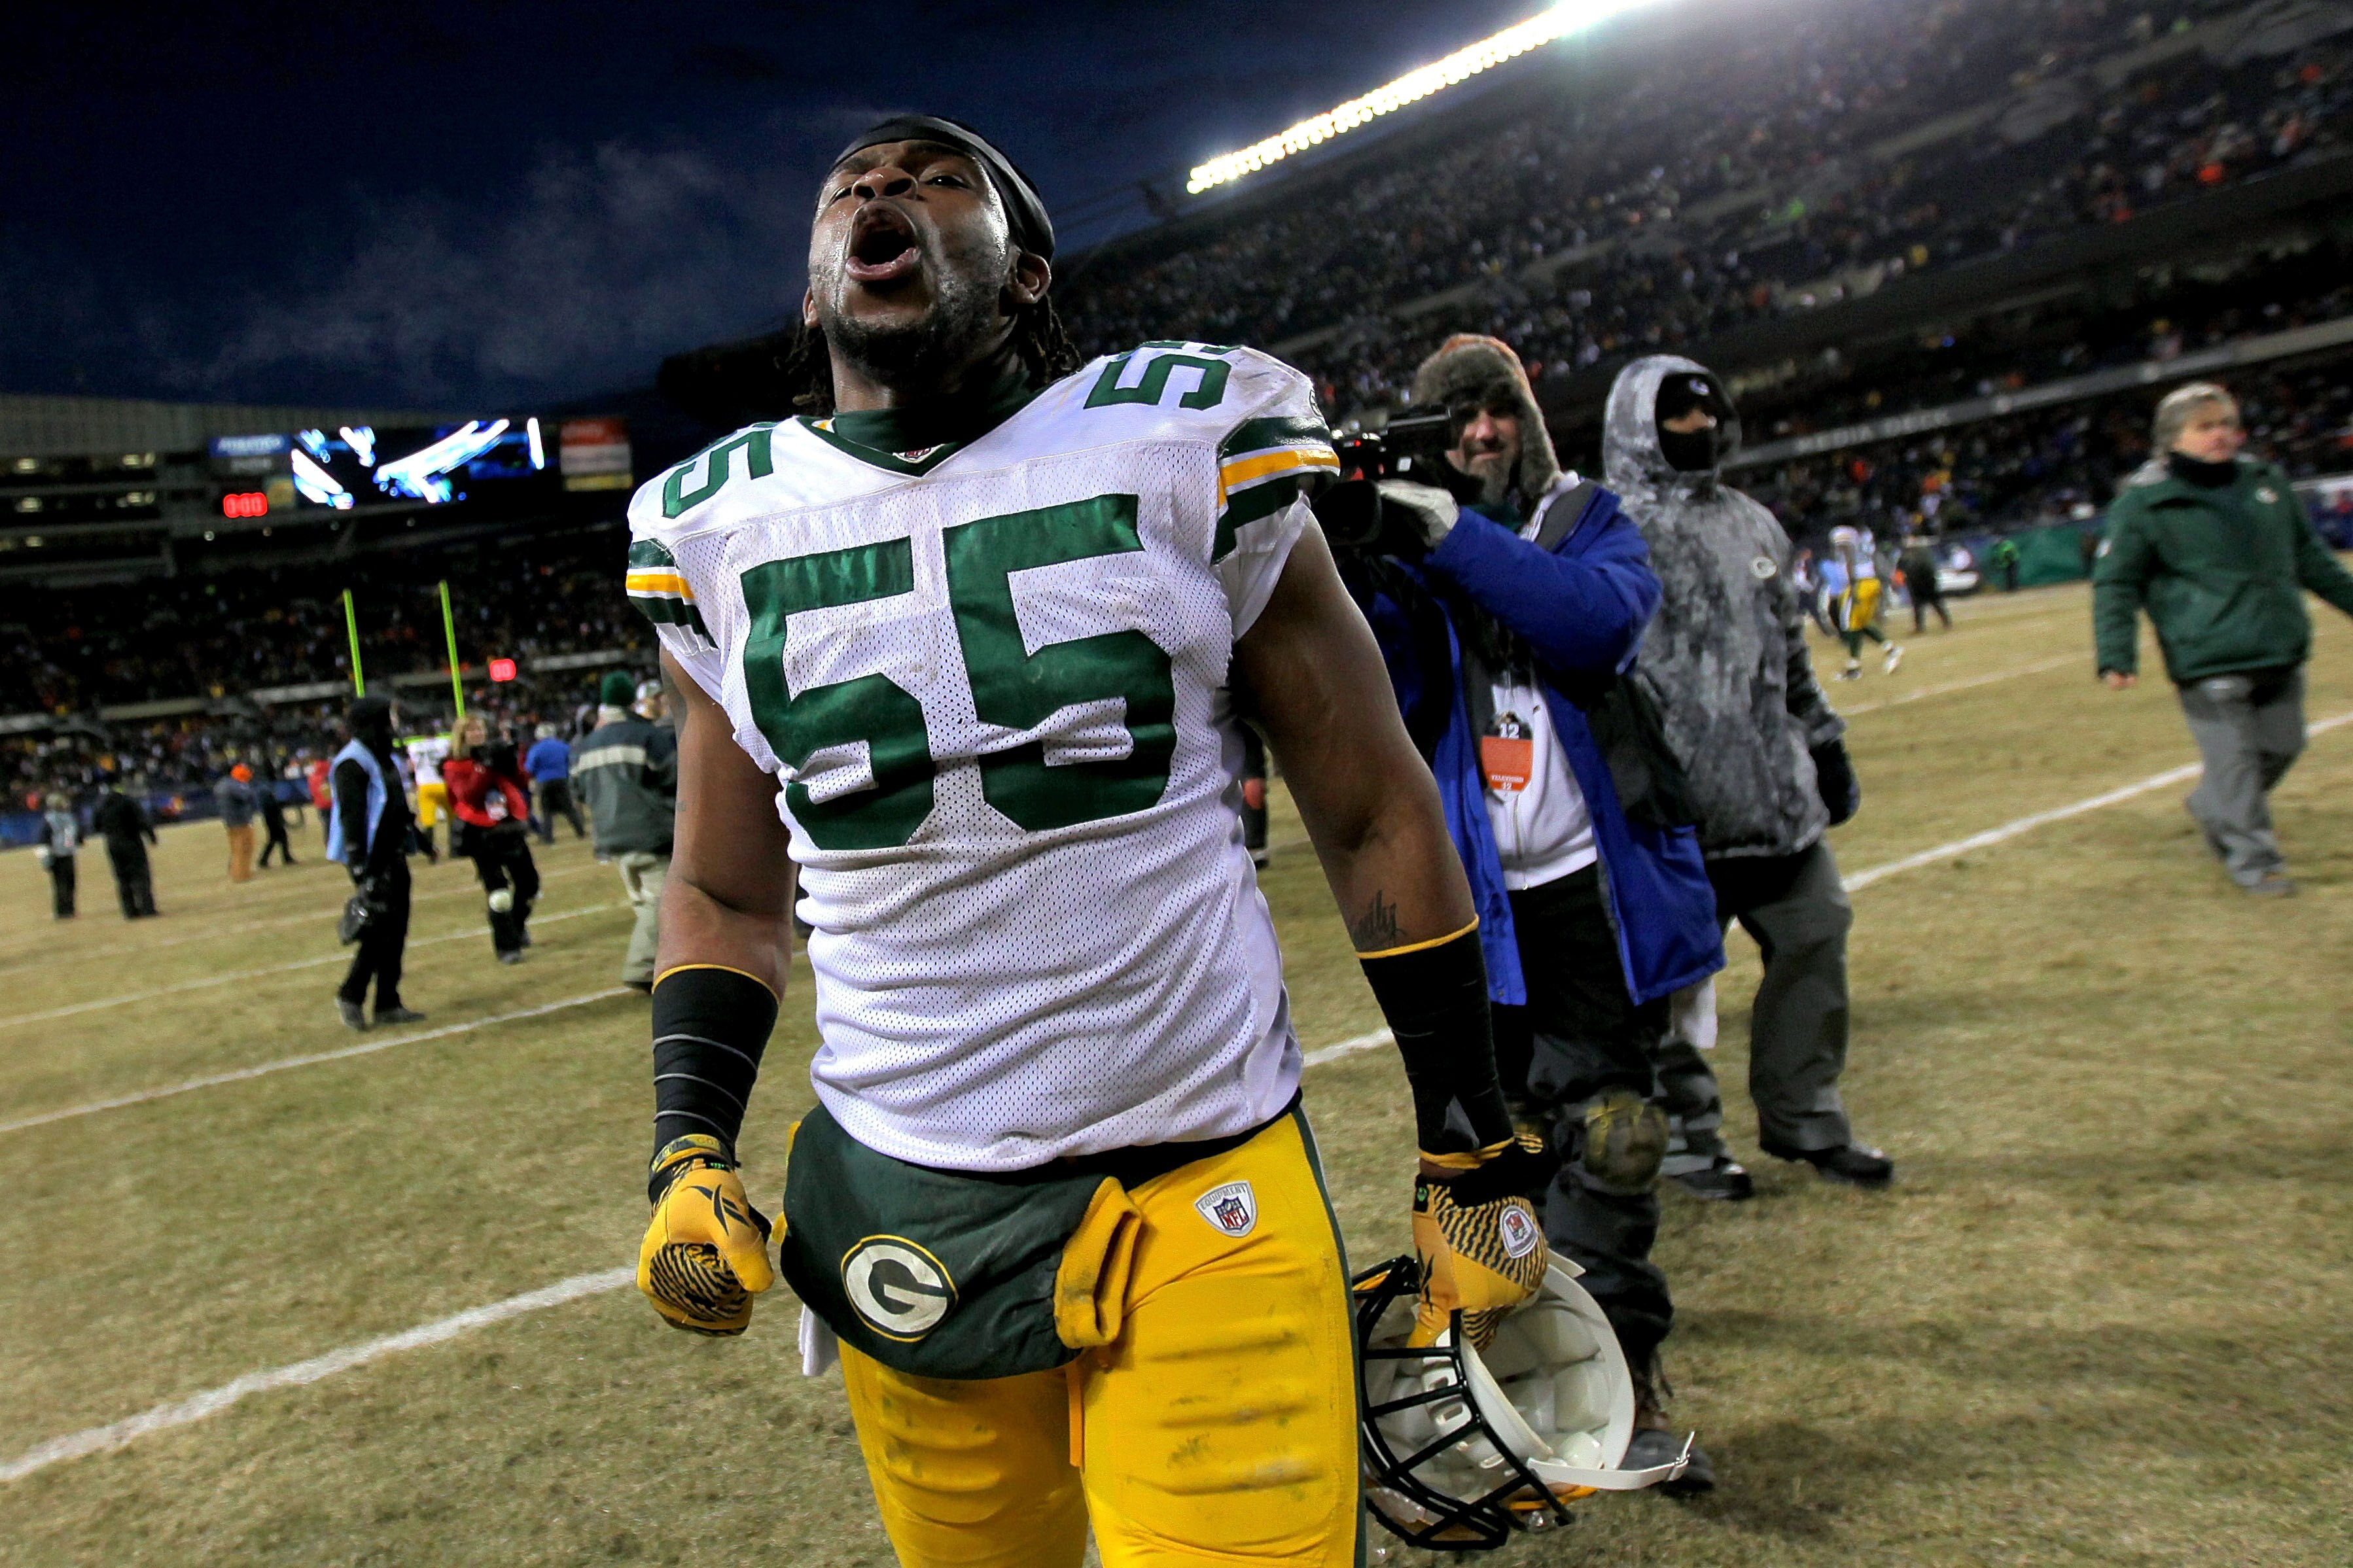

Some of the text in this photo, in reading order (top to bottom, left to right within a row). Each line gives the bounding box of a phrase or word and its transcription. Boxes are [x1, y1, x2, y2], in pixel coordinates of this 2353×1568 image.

[740, 494, 1177, 850] 55
[1500, 723, 1519, 739] 12
[1492, 775, 1524, 783] TELEVISION
[1199, 1184, 1247, 1210] EQUIPMENT
[1221, 1209, 1247, 1229] NFL
[845, 1244, 948, 1333] G
